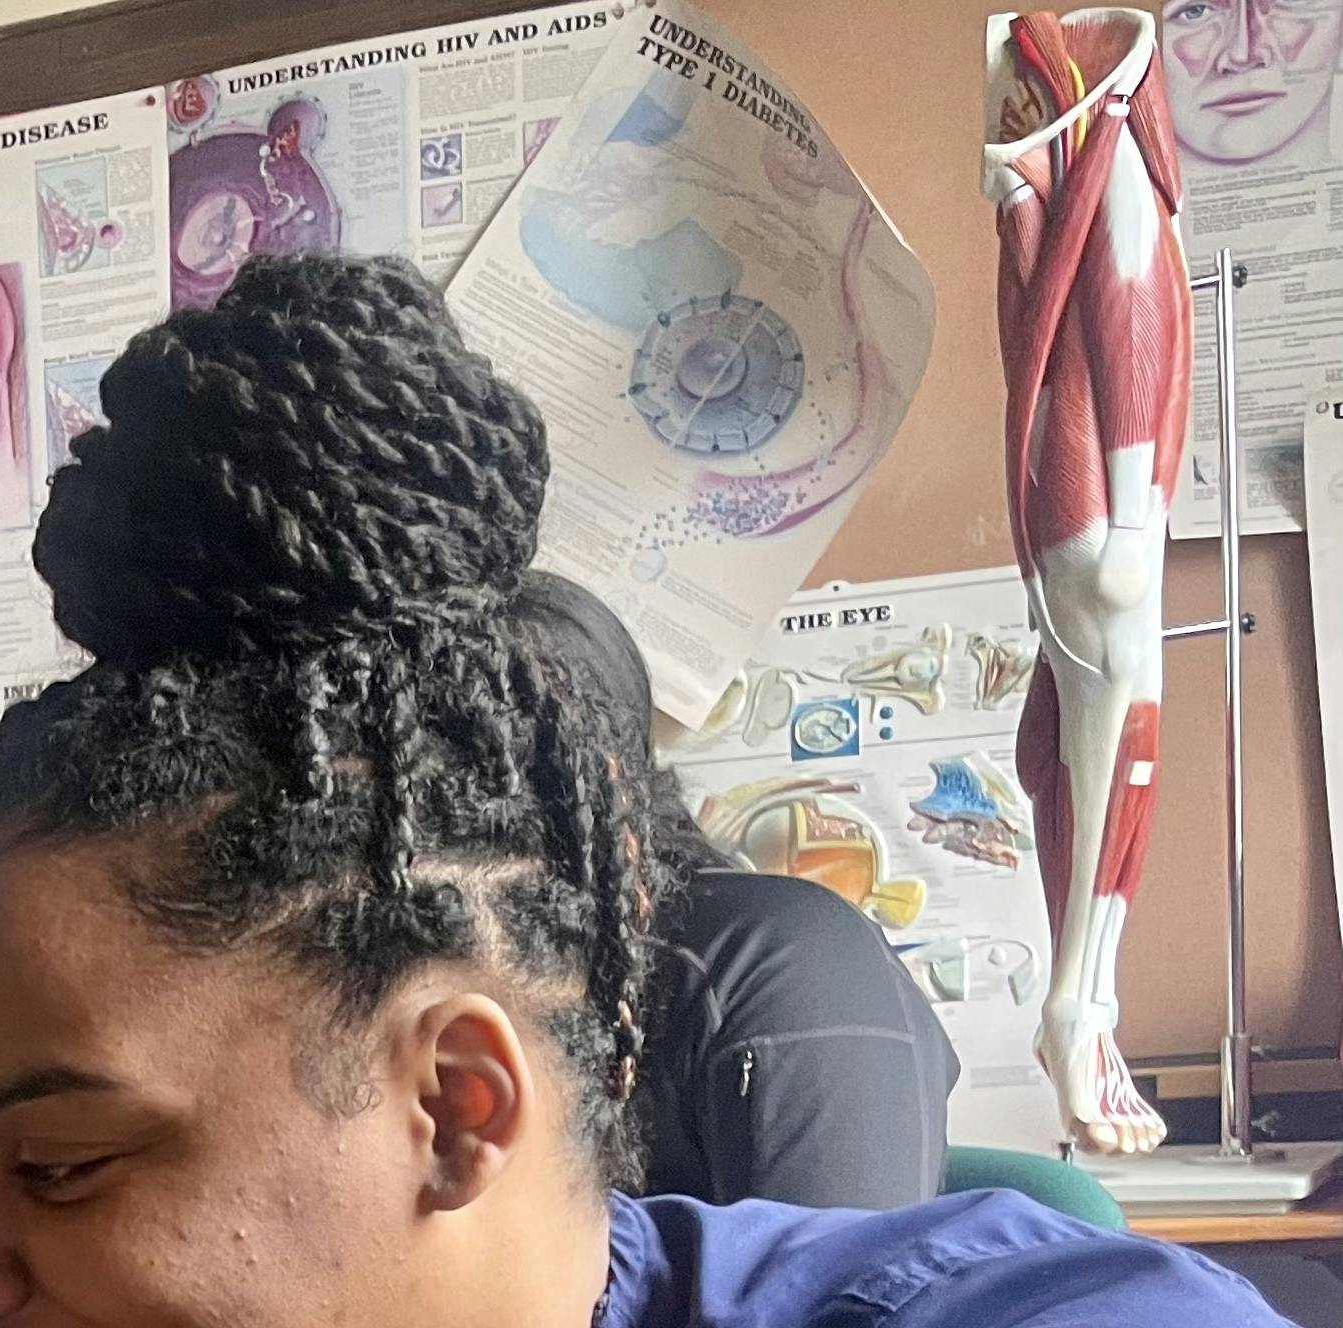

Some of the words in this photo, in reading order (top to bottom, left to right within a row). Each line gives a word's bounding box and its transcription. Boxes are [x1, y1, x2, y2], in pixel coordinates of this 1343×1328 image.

[228, 41, 427, 95] UNDERSTANDING
[436, 31, 481, 55] HIV
[488, 22, 538, 46] AND
[548, 11, 608, 37] AIDS
[649, 14, 811, 133] UNDERSTANDING
[1, 112, 110, 149] DISEASE
[637, 37, 699, 80] TYPE
[722, 80, 818, 158] DIABETES
[780, 611, 833, 634] THE
[840, 604, 893, 627] EYE
